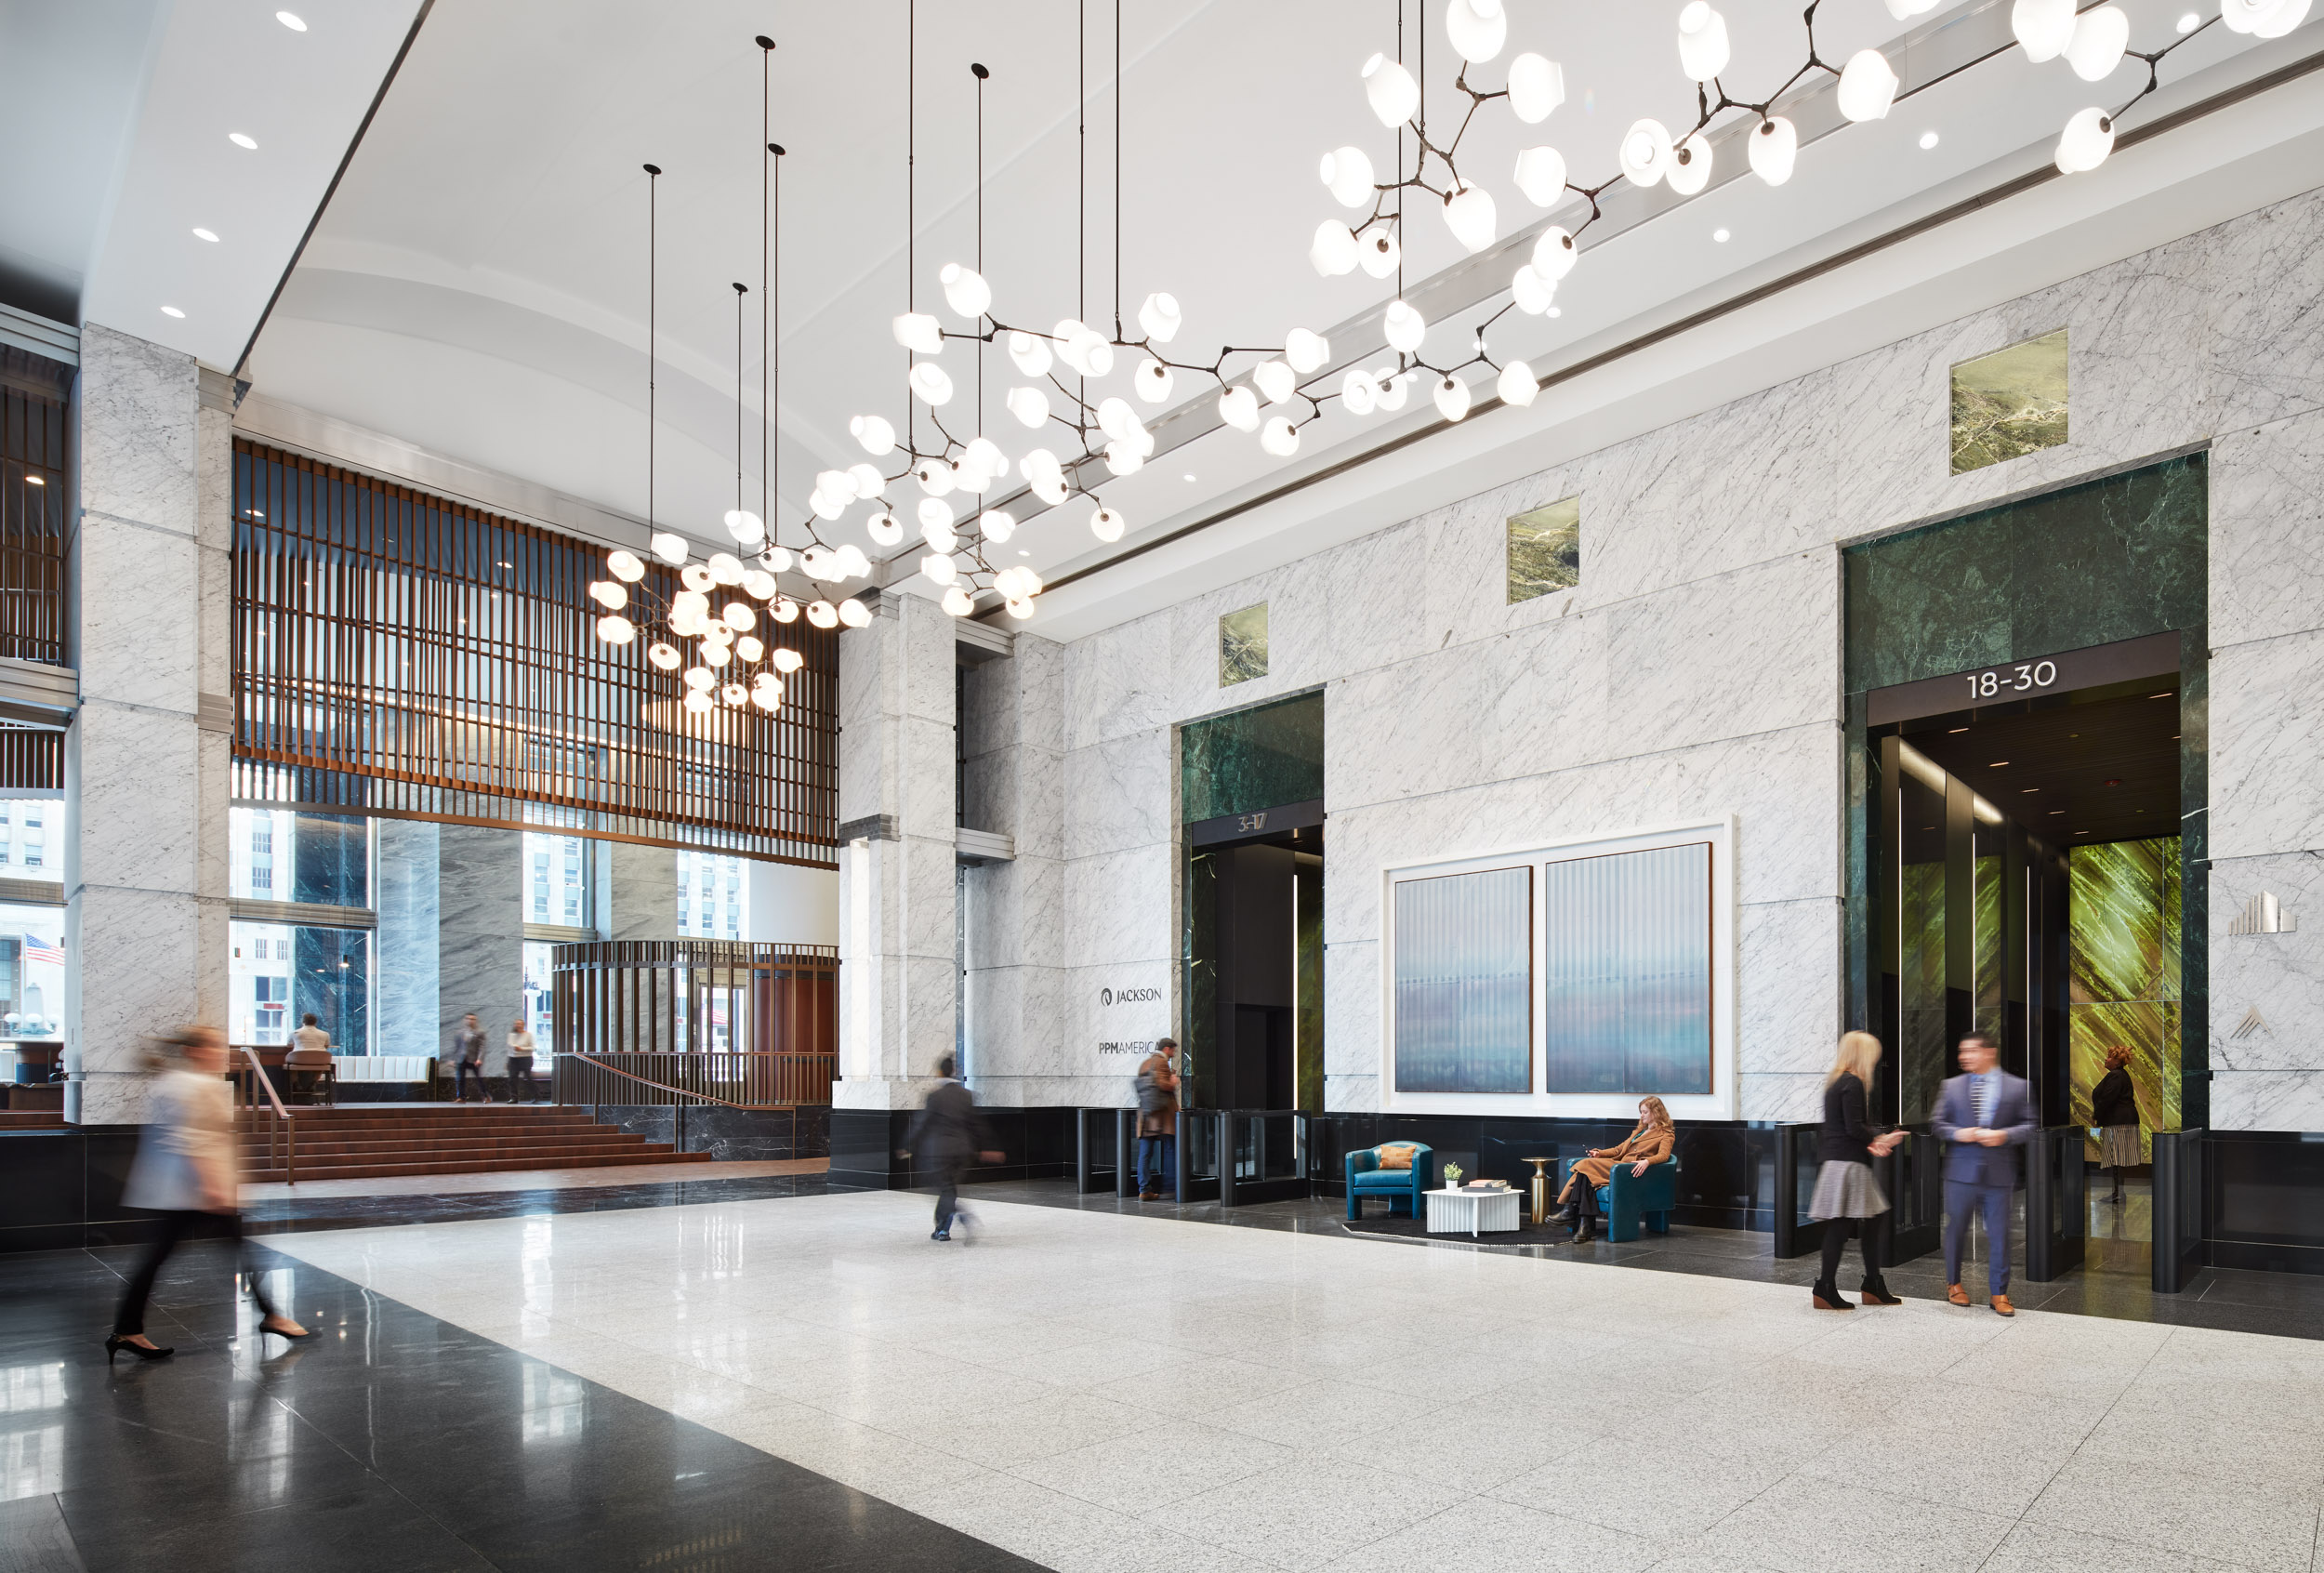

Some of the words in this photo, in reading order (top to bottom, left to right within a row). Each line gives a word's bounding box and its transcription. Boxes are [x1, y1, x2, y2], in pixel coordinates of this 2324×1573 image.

[1967, 661, 2057, 699] 18-30
[1237, 813, 1267, 832] 3-17
[1116, 988, 1162, 1004] JACKSON
